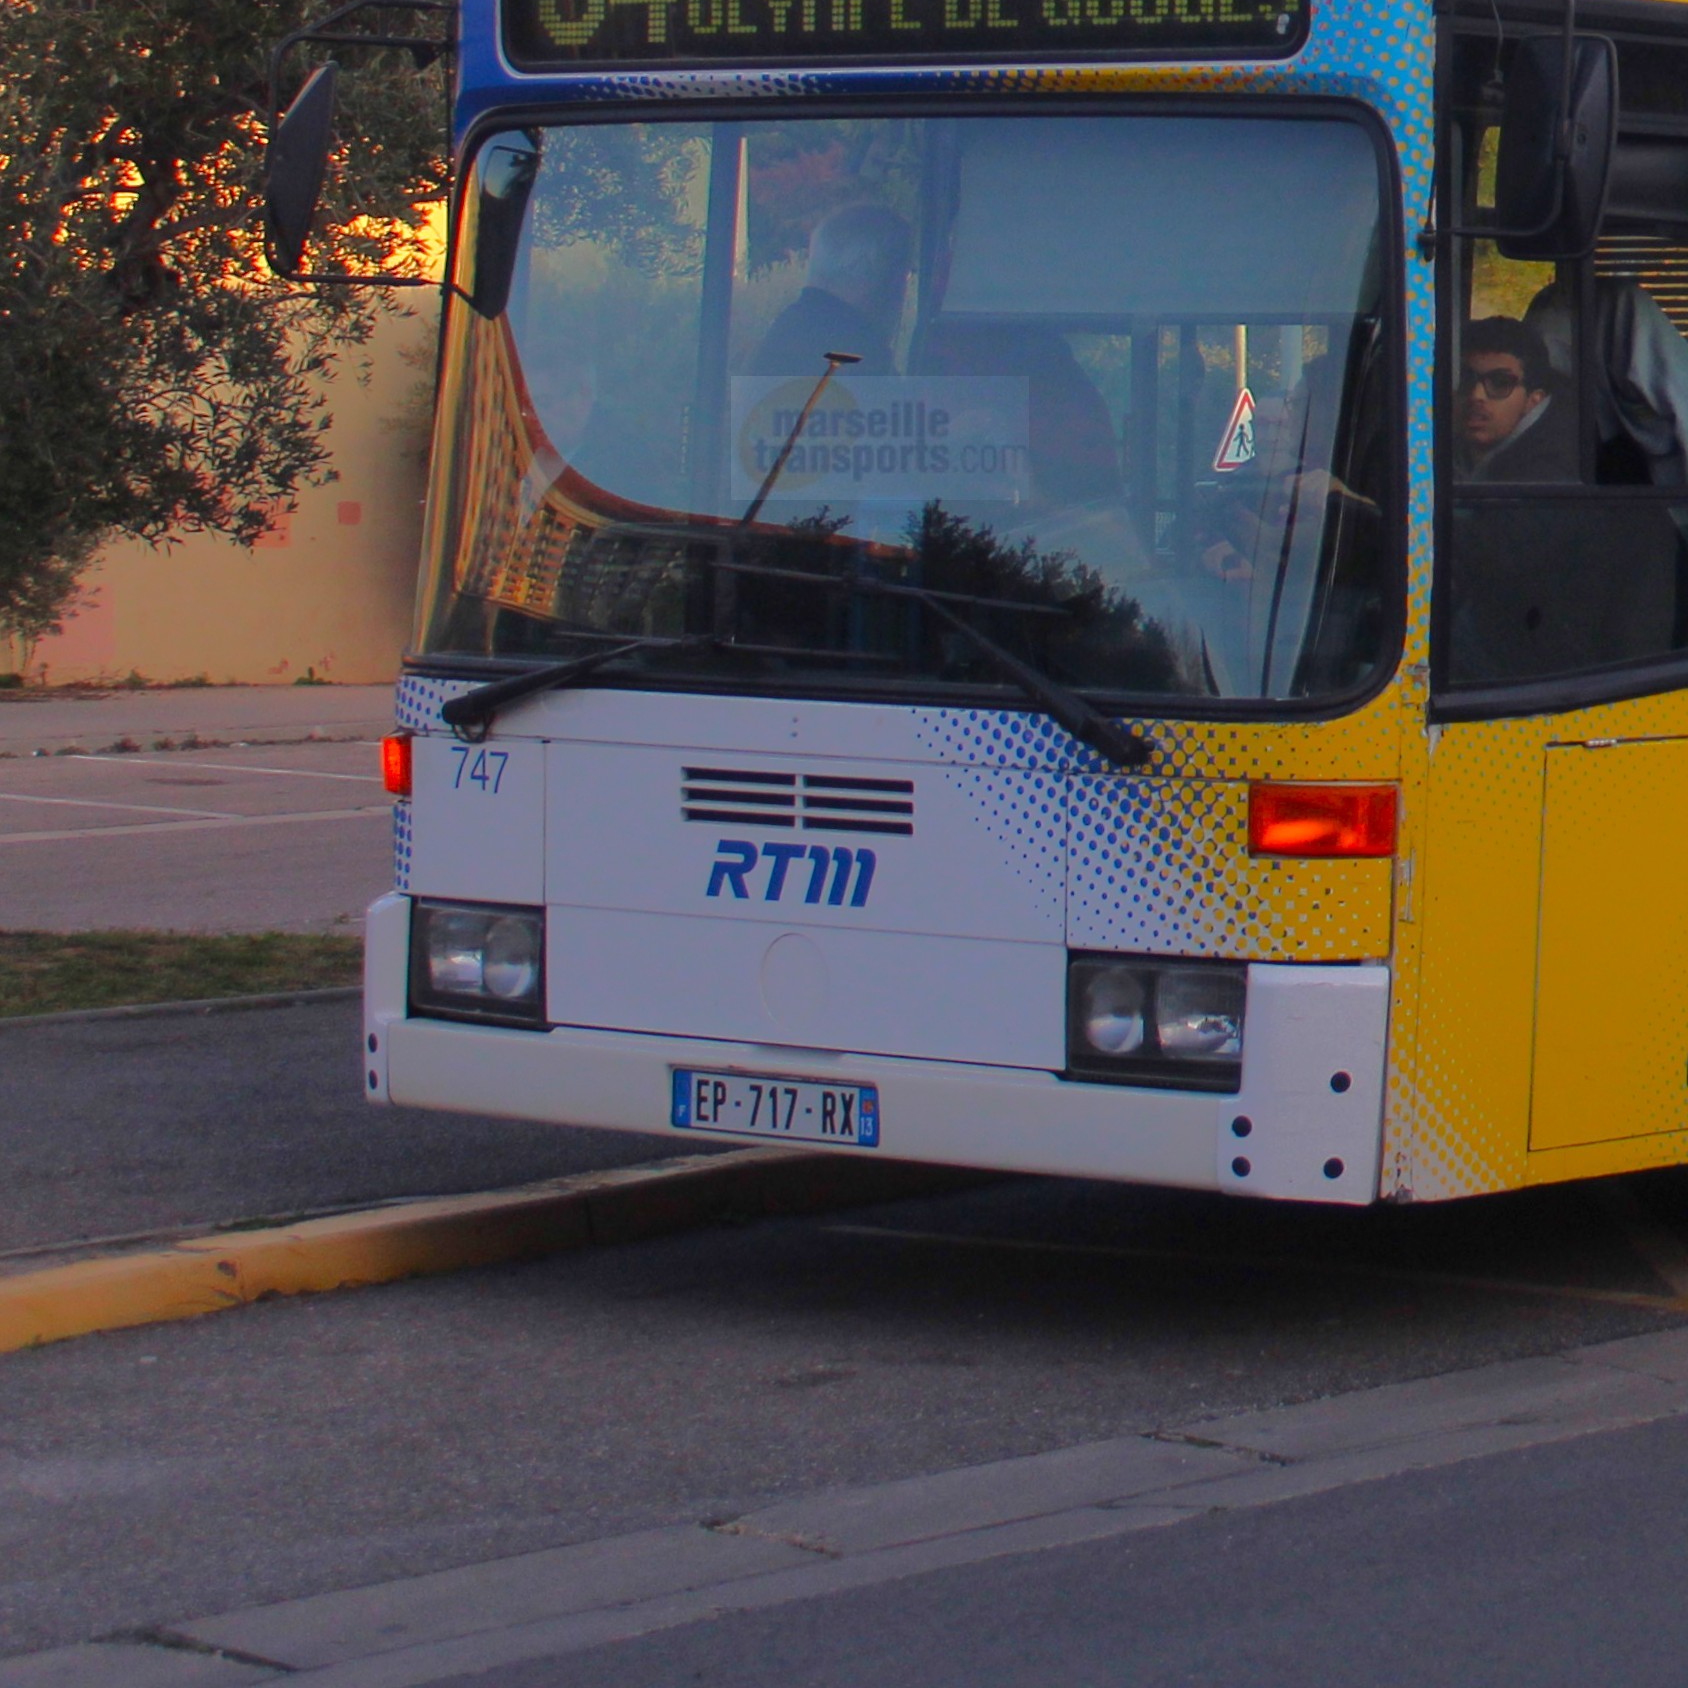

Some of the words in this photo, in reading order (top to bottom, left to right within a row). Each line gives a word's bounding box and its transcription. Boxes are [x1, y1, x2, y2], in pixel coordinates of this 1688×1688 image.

[451, 746, 509, 793] 747
[706, 839, 876, 907] RTM
[860, 1117, 873, 1136] 13
